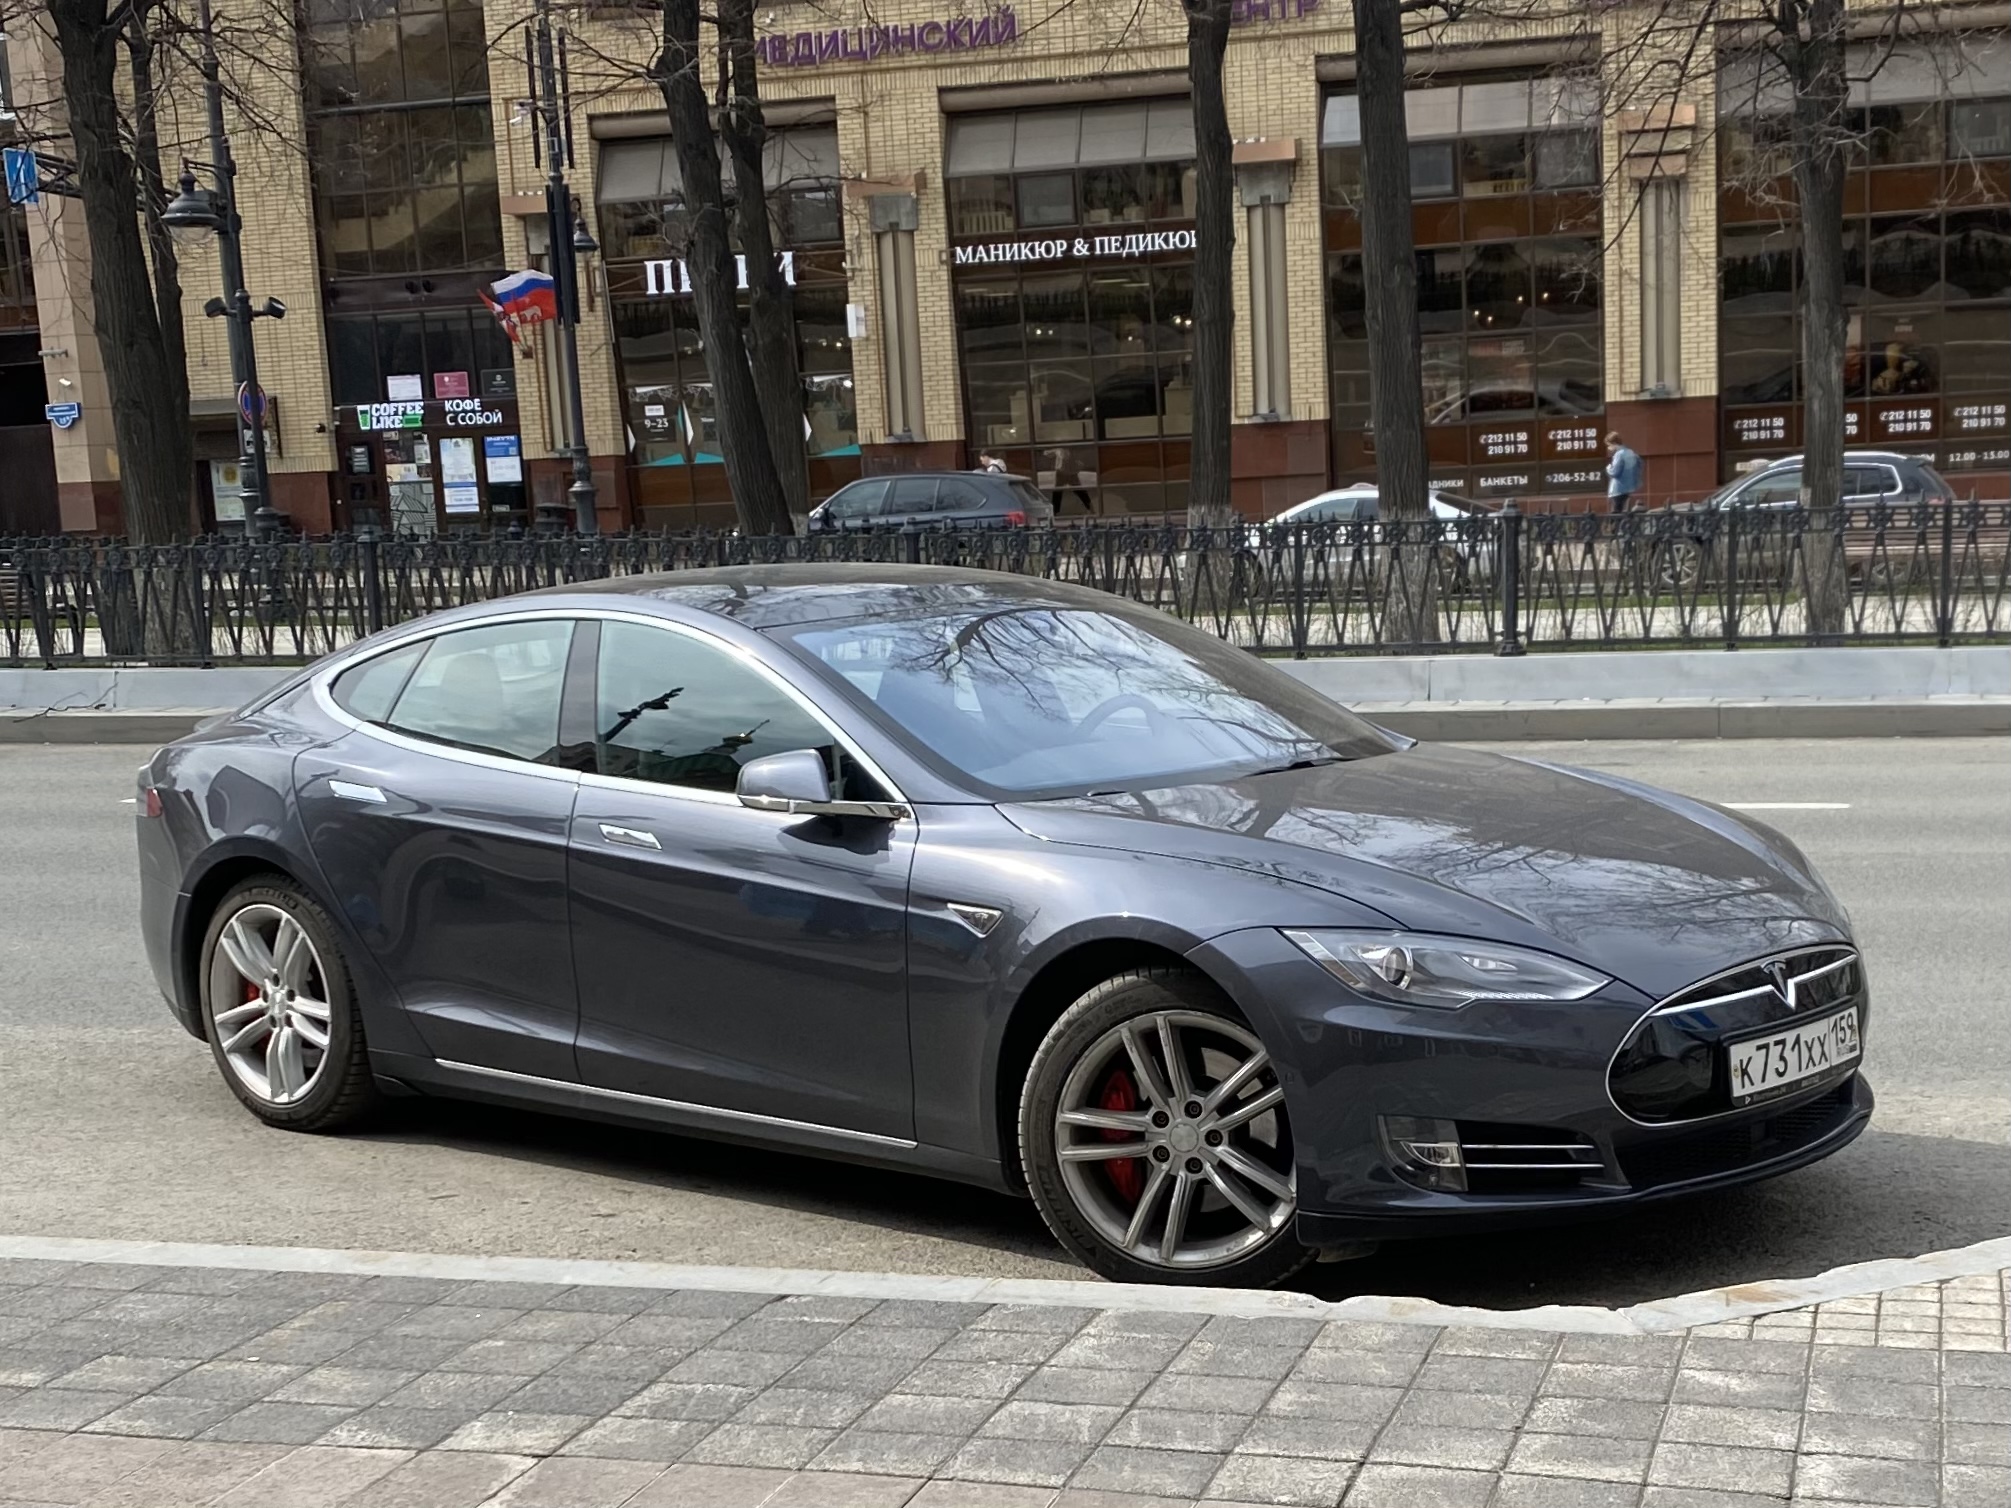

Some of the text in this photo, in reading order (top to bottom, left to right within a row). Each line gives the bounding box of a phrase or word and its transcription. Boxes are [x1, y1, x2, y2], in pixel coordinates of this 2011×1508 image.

[955, 239, 1068, 264] МАНИКЮР
[1073, 238, 1090, 256] &
[371, 401, 425, 417] COFFEE
[444, 399, 482, 412] КОФЕ
[1962, 406, 1979, 416] 212
[446, 409, 503, 426] С СОБОЙ
[1888, 410, 1905, 420] 212
[372, 415, 404, 430] LIKE
[1742, 419, 1758, 428] 212
[1488, 434, 1503, 443] 212
[1556, 430, 1572, 440] 212
[1428, 479, 1464, 489] ДНИКИ
[1480, 475, 1528, 487] БАНКЕТЫ
